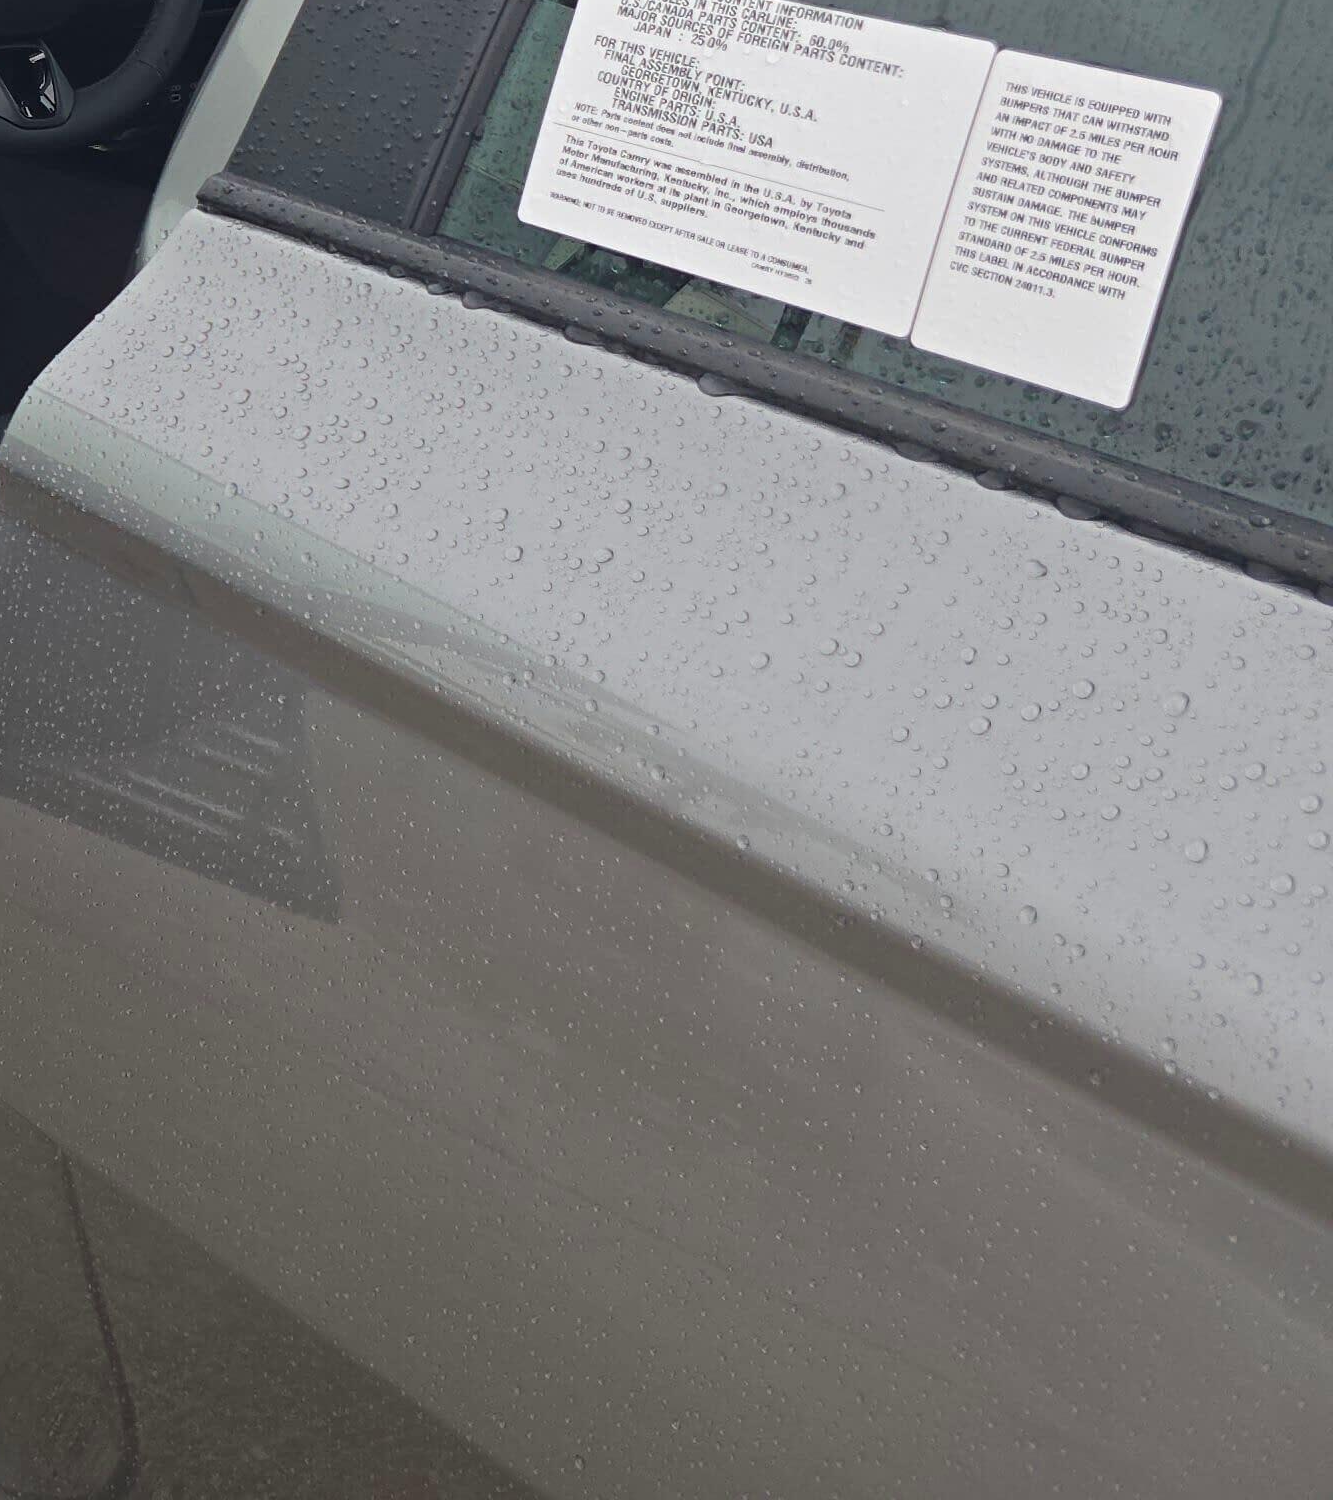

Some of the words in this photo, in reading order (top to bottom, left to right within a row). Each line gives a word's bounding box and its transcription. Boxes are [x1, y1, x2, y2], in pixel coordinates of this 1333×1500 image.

[632, 21, 672, 39] JAPAN
[690, 33, 728, 52] 250%
[697, 10, 738, 29] PARTS
[740, 19, 801, 43] CONTENT:
[711, 1, 738, 17] THIS
[741, 7, 797, 30] CARLINE:
[775, 3, 864, 31] INFORMATION
[593, 34, 617, 50] FOR
[620, 39, 646, 56] THIS
[649, 46, 700, 69] VEHICLE:
[616, 5, 657, 23] MAJOR
[659, 14, 714, 36] SOURCES
[716, 26, 734, 40] OF
[735, 31, 790, 53] FOREIGN
[792, 43, 836, 63] PARTS
[838, 53, 904, 78] CONTENT:
[596, 70, 651, 92] COUNTRY
[653, 84, 669, 97] OF
[671, 88, 716, 110] ORIGIN:
[603, 48, 635, 66] FINAL
[640, 57, 703, 81] ASSEMBLY
[704, 72, 746, 92] POINT:
[613, 86, 656, 106] ENGINE
[658, 97, 701, 118] PARTS:
[704, 109, 741, 129] U.S.A.
[620, 64, 702, 95] GEORGETOWN,
[707, 85, 774, 112] KENTUCKY,
[779, 102, 817, 122] U.S.A.
[1005, 81, 1029, 95] THIS
[1030, 86, 1073, 105] VEHICLE
[1073, 96, 1086, 107] IS
[1086, 99, 1141, 119] EQUIPPED
[1143, 110, 1172, 126] WITH
[611, 97, 698, 129] TRANSMISSION
[700, 120, 745, 141] PARTS:
[748, 131, 773, 149] USA
[994, 111, 1010, 123] AN
[1011, 115, 1052, 132] IMPACT
[1052, 124, 1068, 135] OF
[1087, 132, 1121, 148] MILES
[1122, 140, 1145, 154] PER
[1146, 145, 1179, 162] HOUR
[999, 96, 1050, 115] BUMPERS
[1052, 107, 1080, 122] THAT
[1081, 114, 1104, 128] CAN
[1106, 119, 1170, 142] WITHSTAND
[986, 141, 1037, 161] VEHICLE'S
[1038, 153, 1068, 168] BODY
[1069, 161, 1093, 175] AND
[1094, 166, 1136, 184] SAFETY
[990, 126, 1017, 140] WITH
[1018, 132, 1035, 144] NO
[1036, 136, 1082, 155] DAMAGE
[1084, 147, 1098, 159] TO
[1101, 151, 1122, 165] THE
[561, 145, 589, 160] Motor
[739, 195, 770, 211] which
[820, 216, 876, 240] thousands
[565, 133, 585, 147] This
[587, 139, 618, 156] Toyota
[619, 149, 651, 166] Camry
[653, 159, 673, 171] was
[674, 165, 728, 186] assembled
[730, 179, 741, 190] in
[743, 182, 760, 195] the
[799, 197, 813, 211] by
[816, 201, 852, 220] Toyota
[578, 173, 623, 193] hundreds
[624, 187, 635, 197] of
[975, 171, 998, 184] AND
[999, 176, 1046, 196] RELATED
[1047, 188, 1119, 214] COMPONENTS
[1120, 206, 1147, 221] MAY
[1032, 169, 1089, 191] ALTHOUGH
[1092, 182, 1113, 196] THE
[1114, 188, 1162, 208] BUMPER
[558, 157, 569, 166] of
[569, 159, 614, 179] American
[616, 173, 655, 190] workers
[656, 185, 667, 194] at
[668, 187, 681, 198] its
[682, 192, 709, 206] plant
[710, 199, 721, 209] in
[792, 221, 842, 244] Kentucky
[843, 237, 865, 250] and
[971, 186, 1015, 205] SUSTAIN
[1067, 209, 1088, 223] THE
[1089, 215, 1136, 236] BUMPER
[963, 215, 976, 227] TO
[979, 219, 998, 233] THE
[1000, 225, 1049, 245] CURRENT
[1049, 238, 1096, 259] FEDERAL
[1098, 251, 1146, 272] BUMPER
[966, 200, 1008, 219] SYSTEM
[1009, 211, 1025, 224] ON
[1028, 215, 1052, 230] THIS
[1054, 222, 1097, 242] VEHICLE
[1098, 234, 1158, 258] CONFORMS
[949, 260, 969, 274] CVC
[970, 266, 1013, 286] SECTION
[955, 245, 977, 259] THIS
[978, 251, 1009, 269] LABEL
[1011, 261, 1024, 272] IN
[1024, 265, 1096, 292] ACCORDANCE
[1097, 283, 1126, 301] WITH
[957, 230, 1012, 253] STANDARD
[1013, 245, 1029, 256] OF
[1048, 254, 1081, 271] MILES
[1082, 263, 1105, 278] PER
